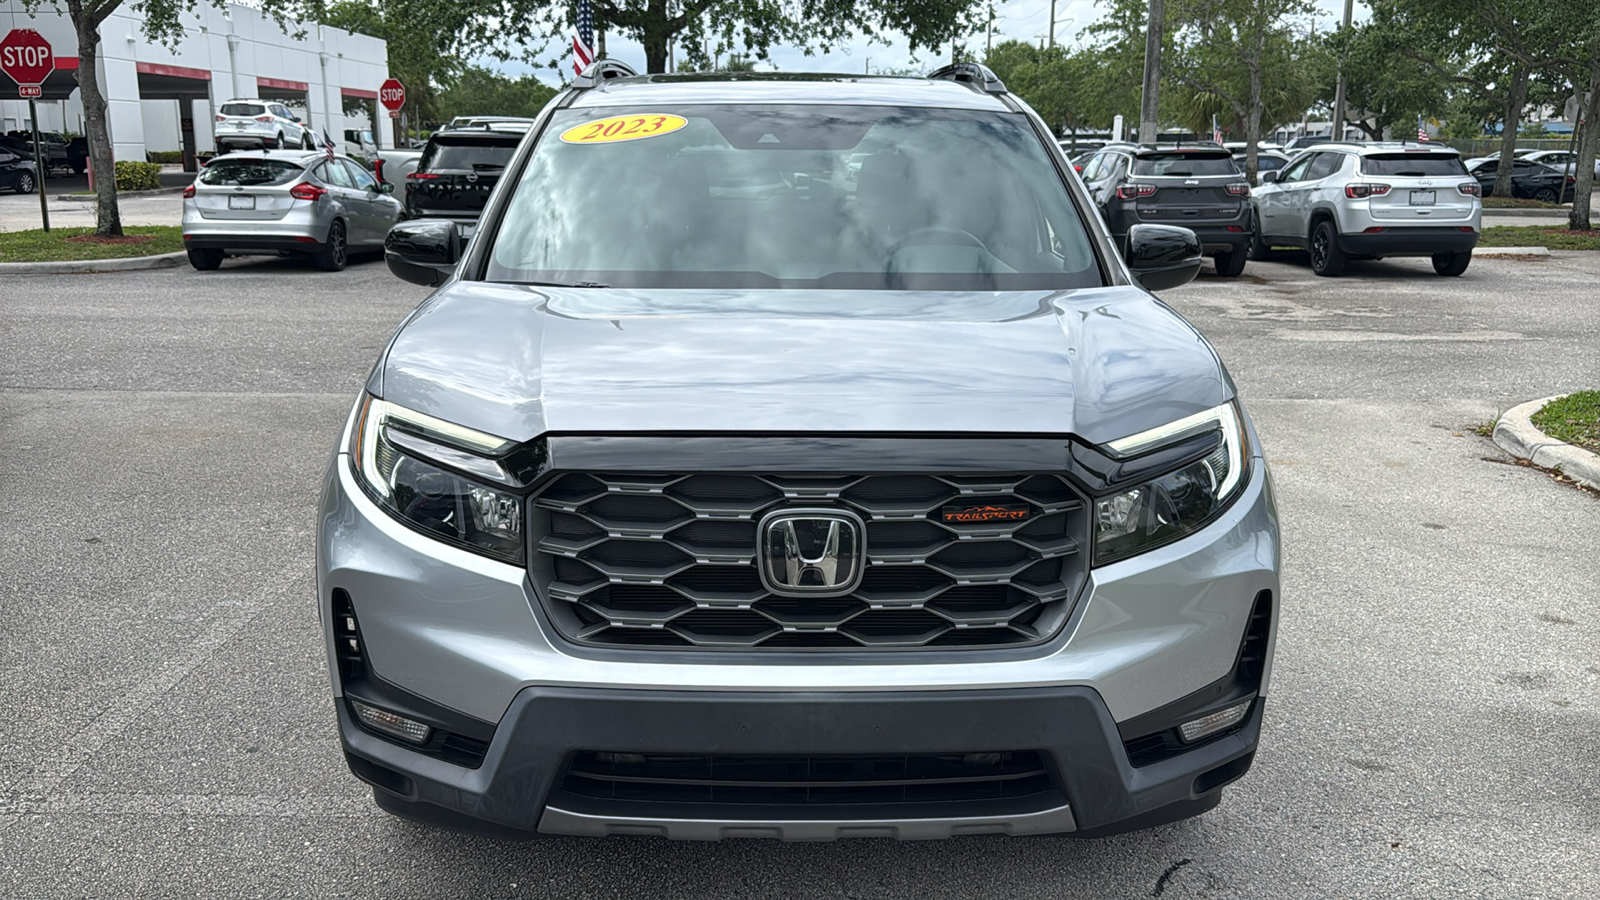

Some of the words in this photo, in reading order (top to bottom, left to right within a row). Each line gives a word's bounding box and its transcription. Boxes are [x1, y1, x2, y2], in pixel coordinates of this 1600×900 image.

[3, 46, 49, 67] STOP
[381, 88, 404, 102] STOP
[580, 116, 667, 141] 2023
[428, 183, 495, 192] PATHFIN
[944, 510, 1028, 522] TRAILSPORT
